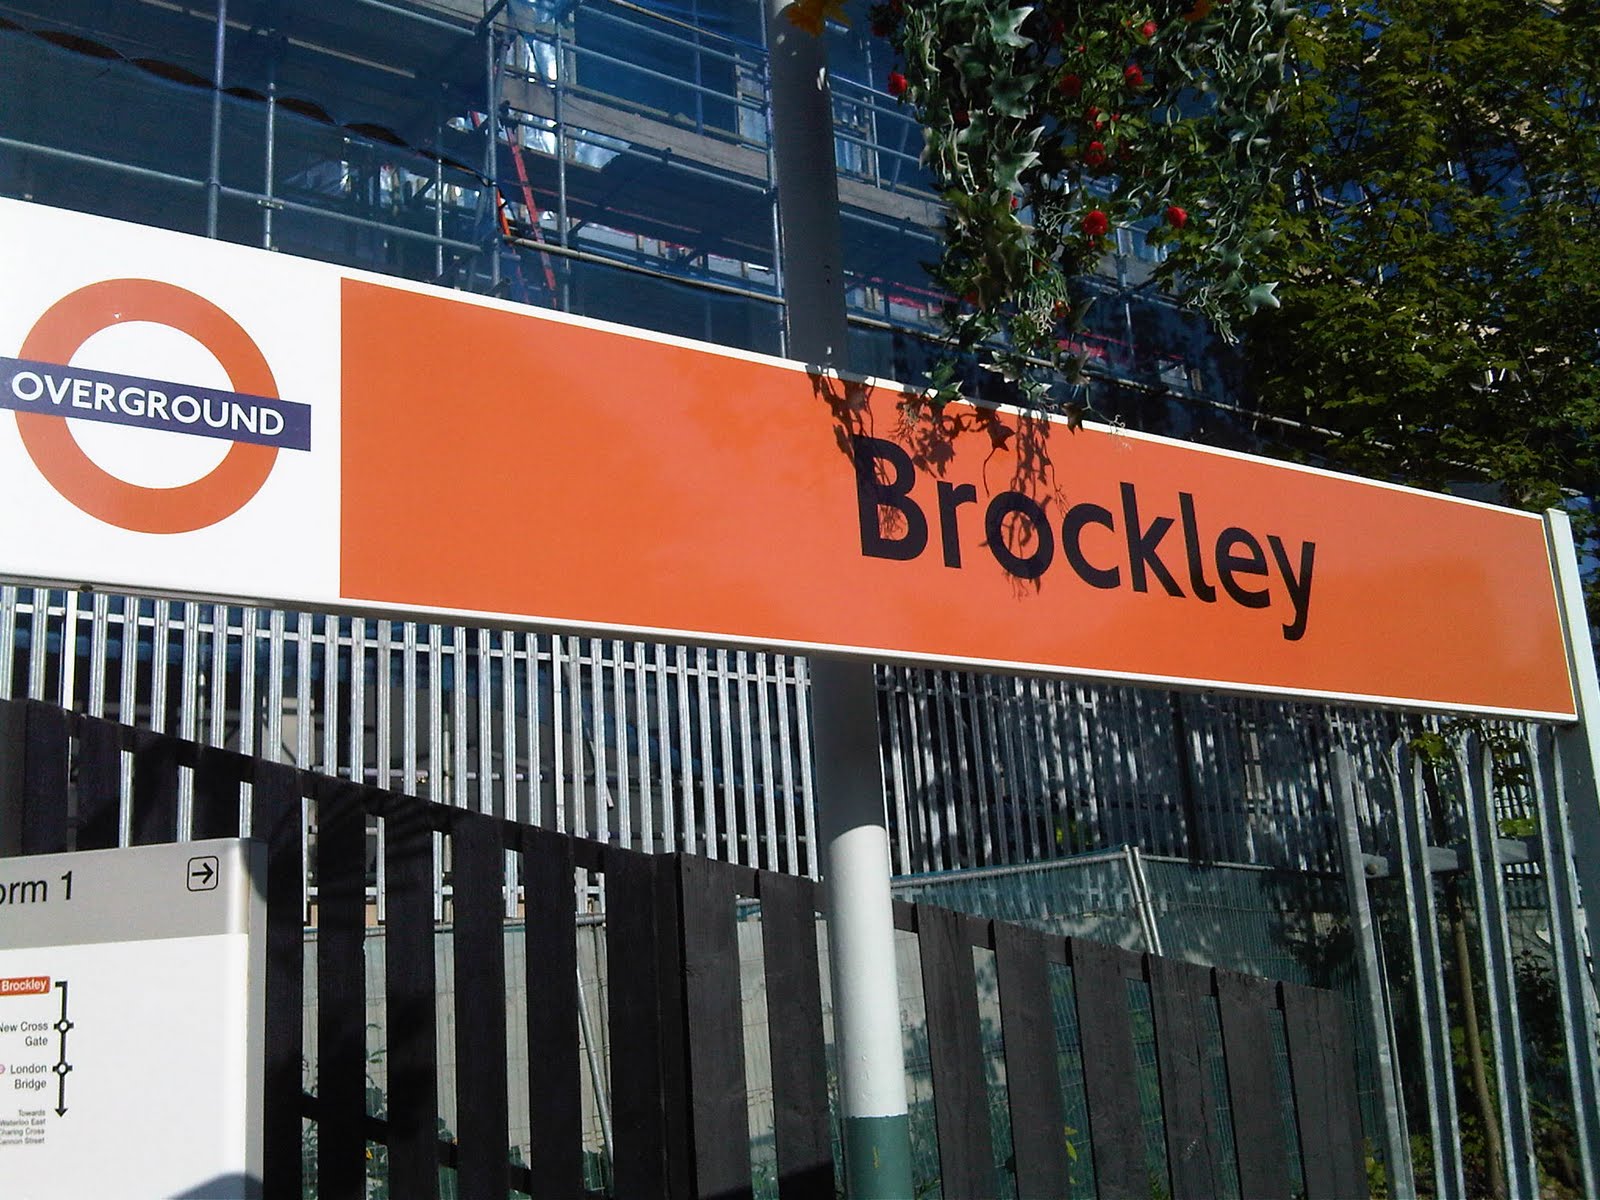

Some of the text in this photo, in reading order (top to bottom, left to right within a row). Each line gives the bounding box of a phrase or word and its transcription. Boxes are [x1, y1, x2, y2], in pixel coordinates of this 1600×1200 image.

[11, 371, 285, 436] OVERGROUND
[854, 434, 1316, 641] Brockley
[61, 870, 72, 900] 1
[1, 979, 47, 992] Brockley
[20, 1021, 48, 1032] Cross
[25, 1036, 48, 1047] Gate
[10, 1064, 47, 1074] London
[14, 1079, 47, 1091] Bridge
